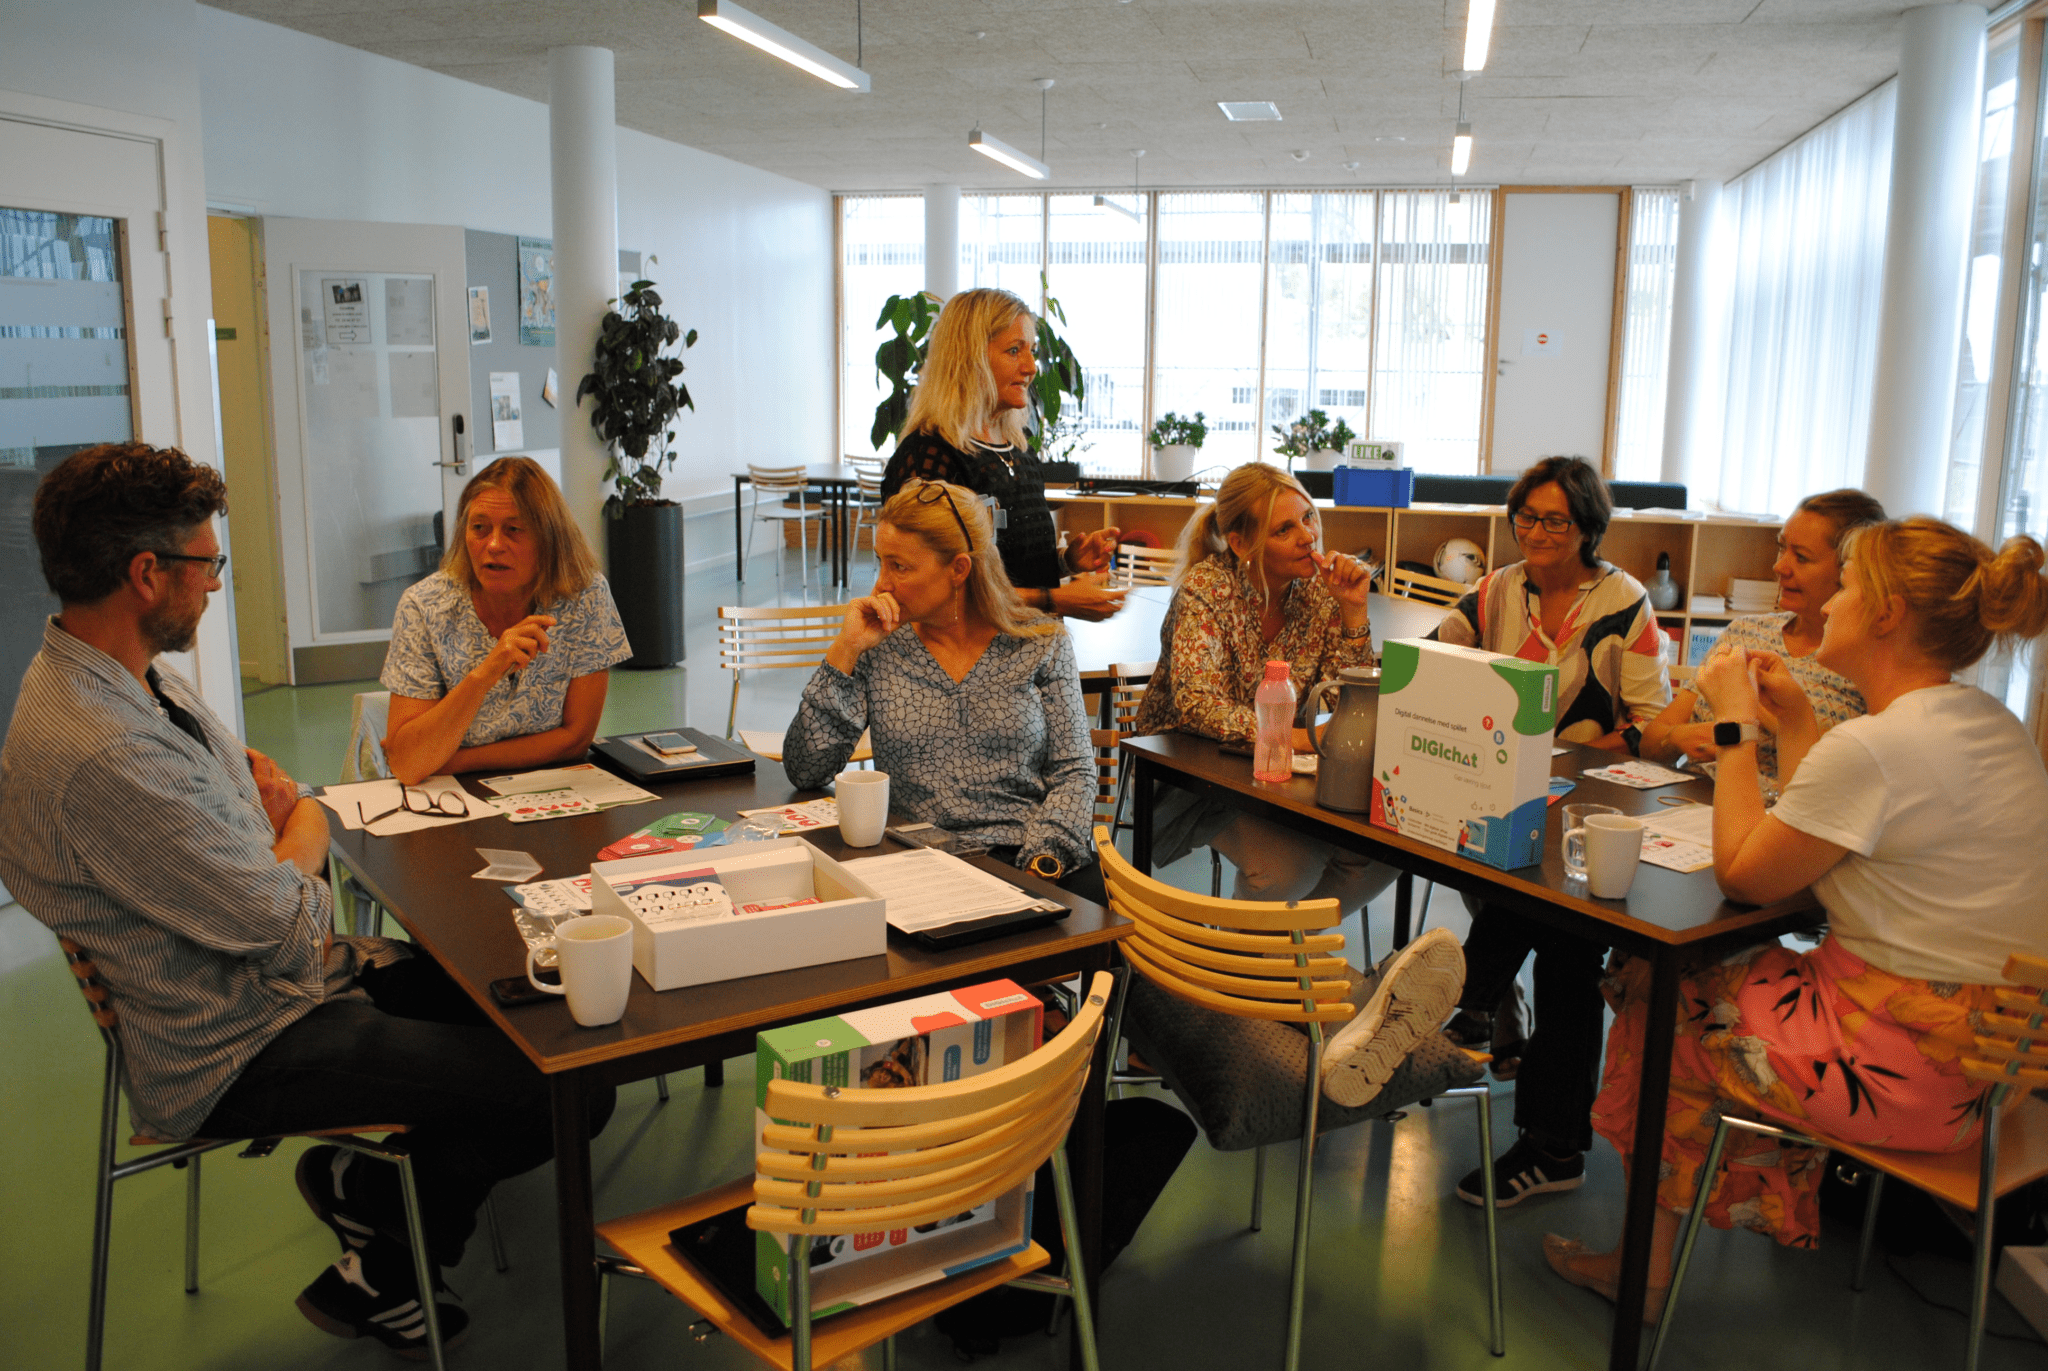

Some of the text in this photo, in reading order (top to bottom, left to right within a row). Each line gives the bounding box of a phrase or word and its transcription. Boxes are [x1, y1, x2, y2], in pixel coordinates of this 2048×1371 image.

[1353, 445, 1380, 459] LIKE
[1394, 707, 1467, 733] Digital dannelse med spillet
[1411, 734, 1478, 768] DIGIchat
